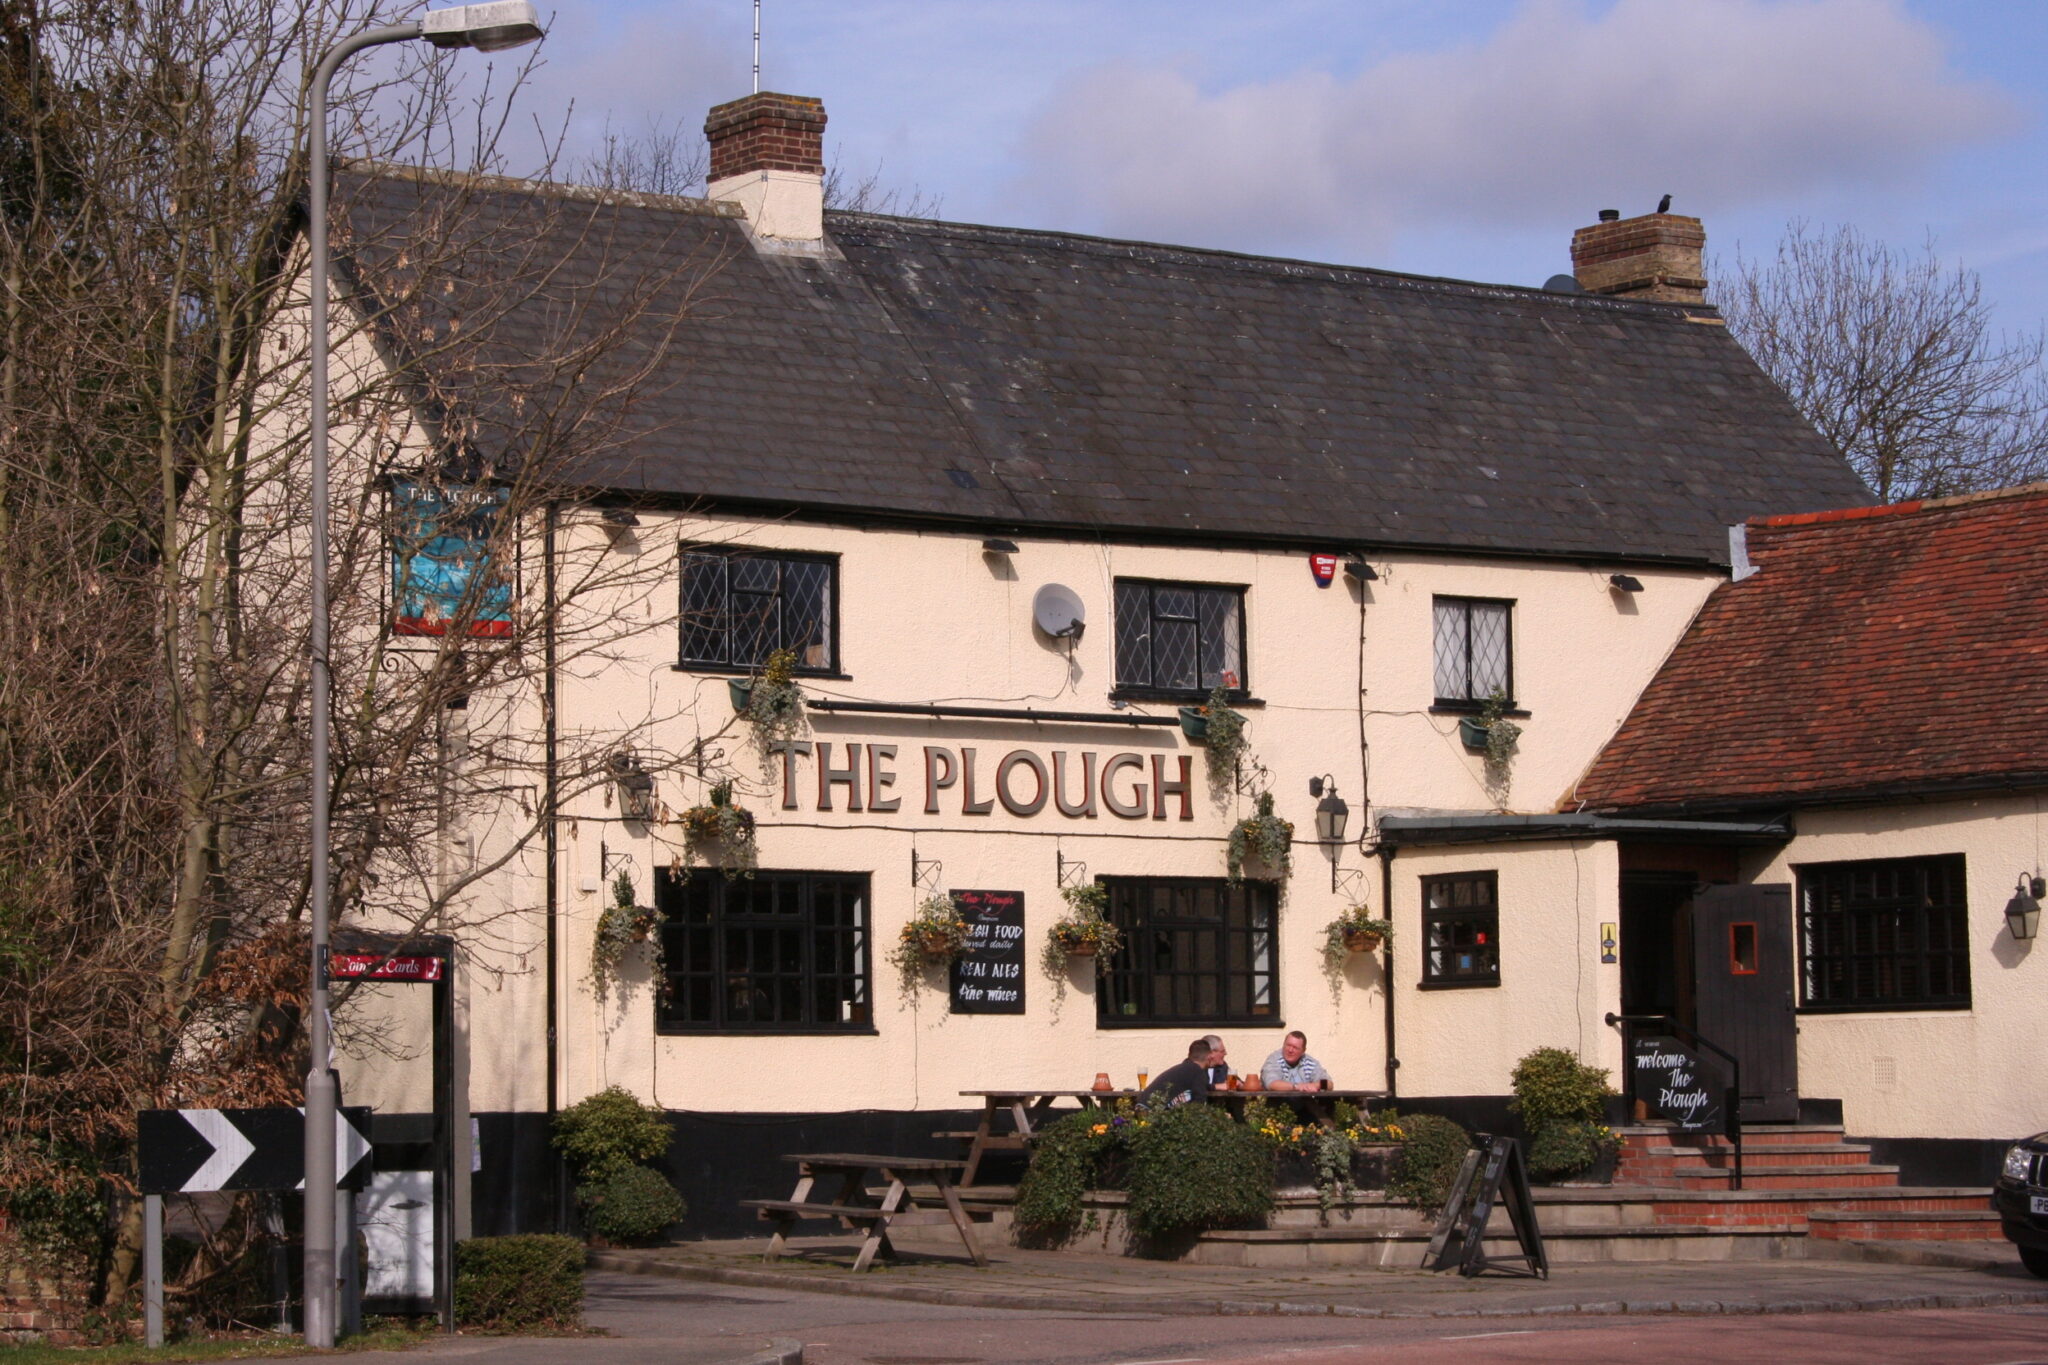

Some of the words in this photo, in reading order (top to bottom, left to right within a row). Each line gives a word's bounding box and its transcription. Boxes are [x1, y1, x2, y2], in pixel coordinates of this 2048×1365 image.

[769, 740, 901, 812] THE
[923, 746, 1194, 821] PLOUGH
[995, 924, 1023, 939] FOOD
[990, 939, 1013, 949] daily
[386, 959, 420, 973] Cards
[960, 961, 986, 976] REAL
[992, 962, 1019, 978] ALES
[986, 985, 1018, 1002] wines
[1635, 1050, 1687, 1069] welcome
[1668, 1068, 1694, 1087] The
[1659, 1088, 1708, 1121] Plough
